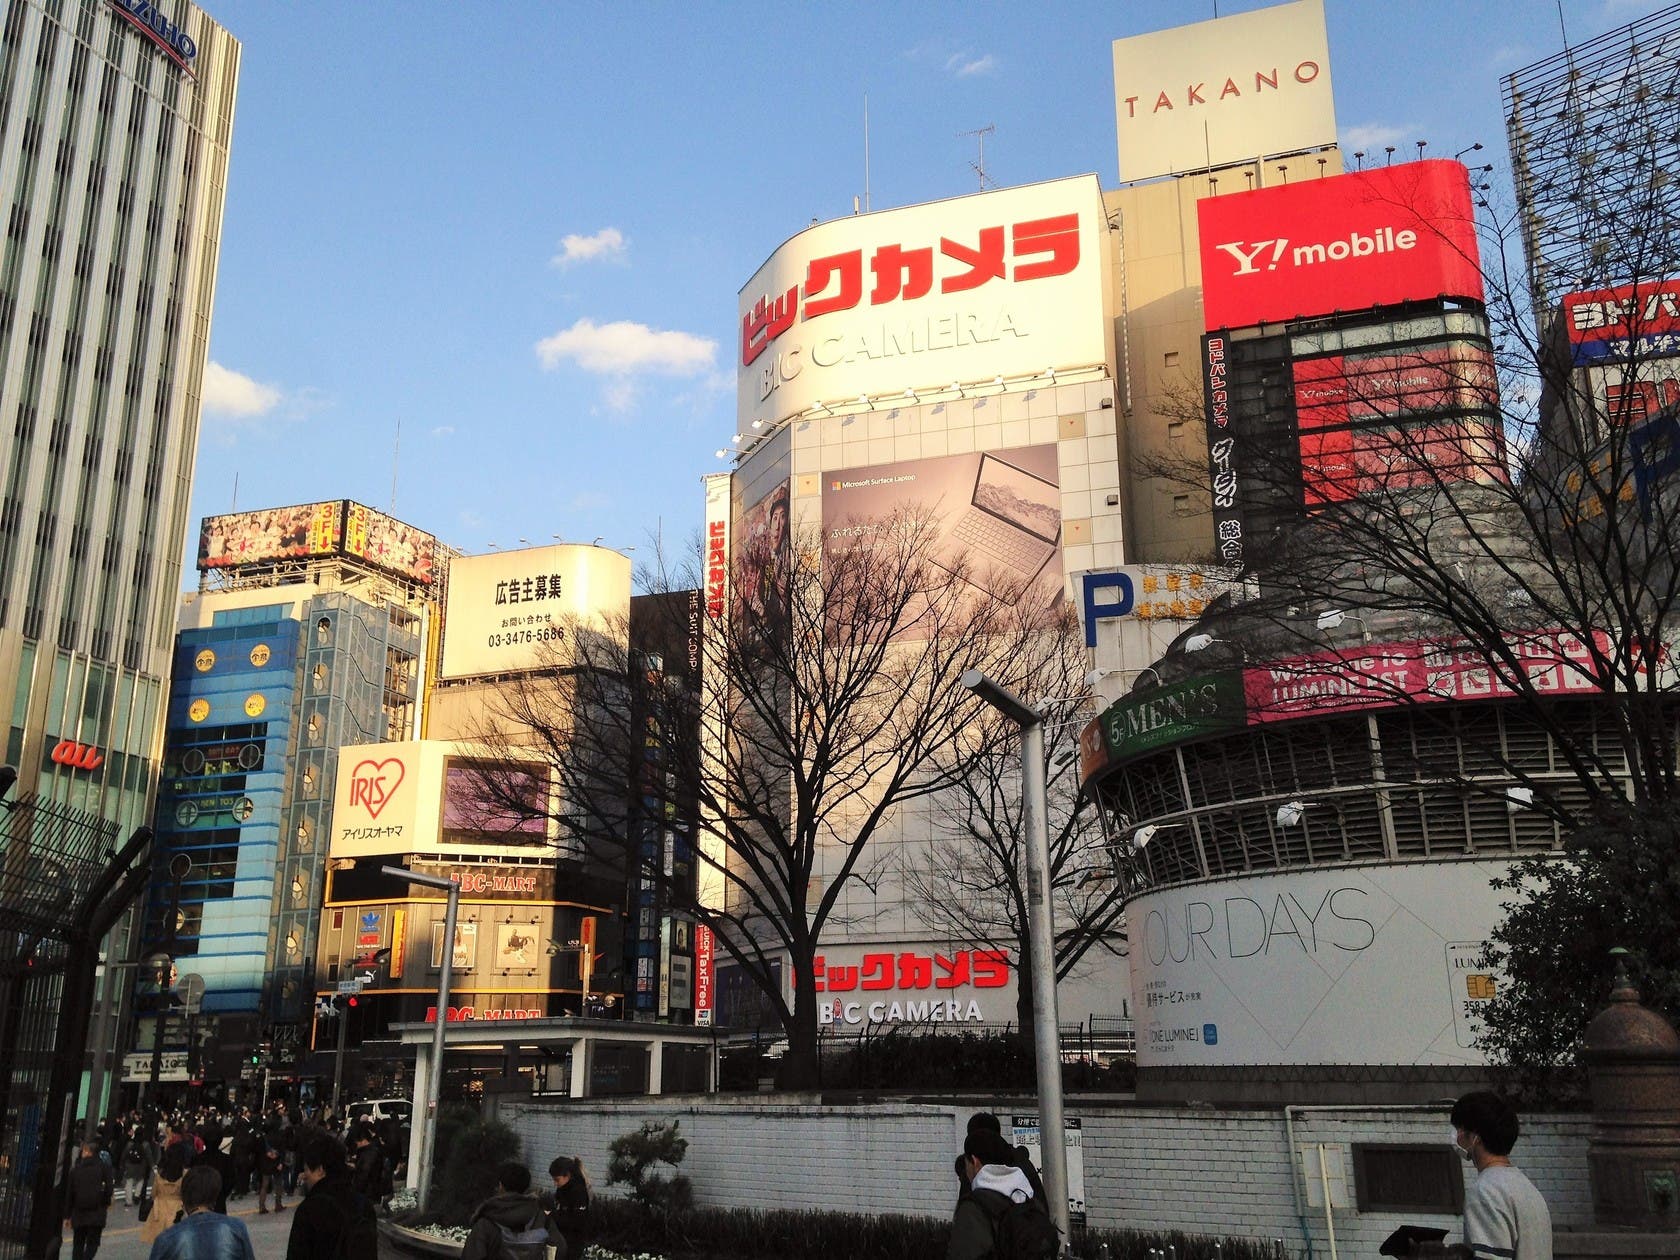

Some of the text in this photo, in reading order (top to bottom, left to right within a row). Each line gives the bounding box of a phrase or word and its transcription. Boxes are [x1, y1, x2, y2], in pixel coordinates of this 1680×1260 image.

[1125, 60, 1320, 118] TAKANO
[743, 212, 1081, 367] ビックカメラ
[760, 307, 1030, 402] BIC CAMERA
[1208, 337, 1229, 429] ヨドバシカメラ
[842, 473, 916, 489] Microsoft Surface Laptop
[495, 574, 562, 606] 広告主募集
[689, 589, 699, 610] THE
[501, 613, 552, 629] お問い合わせ
[1083, 573, 1134, 648] P
[688, 612, 698, 636] SUIT
[488, 626, 565, 648] 03-3476-5686
[1382, 650, 1408, 668] to
[51, 740, 104, 770] au
[349, 776, 387, 807] IRIS
[341, 825, 403, 841] アイリスオーヤマ
[449, 873, 536, 893] ABC-MART
[1144, 888, 1375, 966] OUR DAYS
[697, 1019, 710, 1027] VISA
[868, 999, 985, 1024] CAMERA
